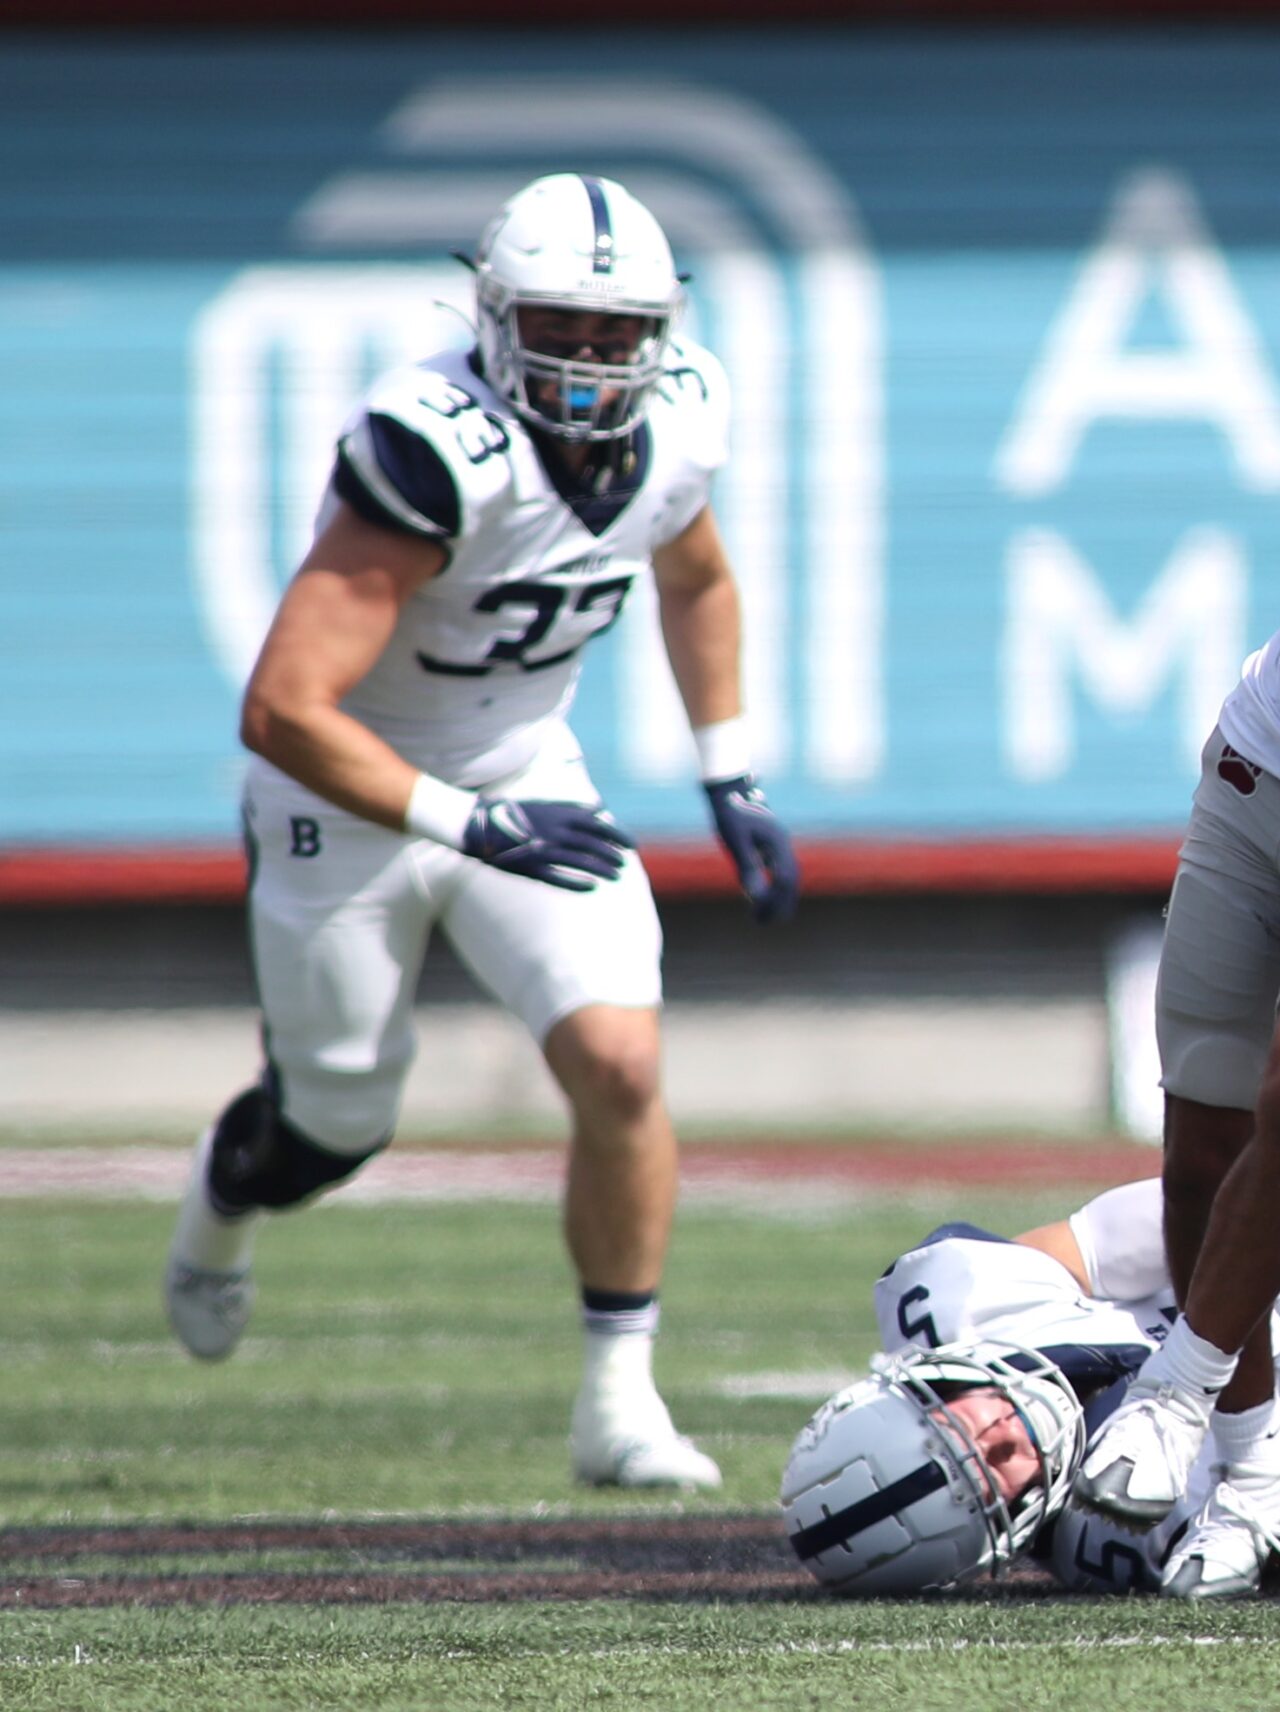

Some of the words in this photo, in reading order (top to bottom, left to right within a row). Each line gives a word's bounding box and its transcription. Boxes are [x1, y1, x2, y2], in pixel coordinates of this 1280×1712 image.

[418, 382, 510, 465] 33
[290, 816, 322, 857] B
[897, 1285, 944, 1349] 5
